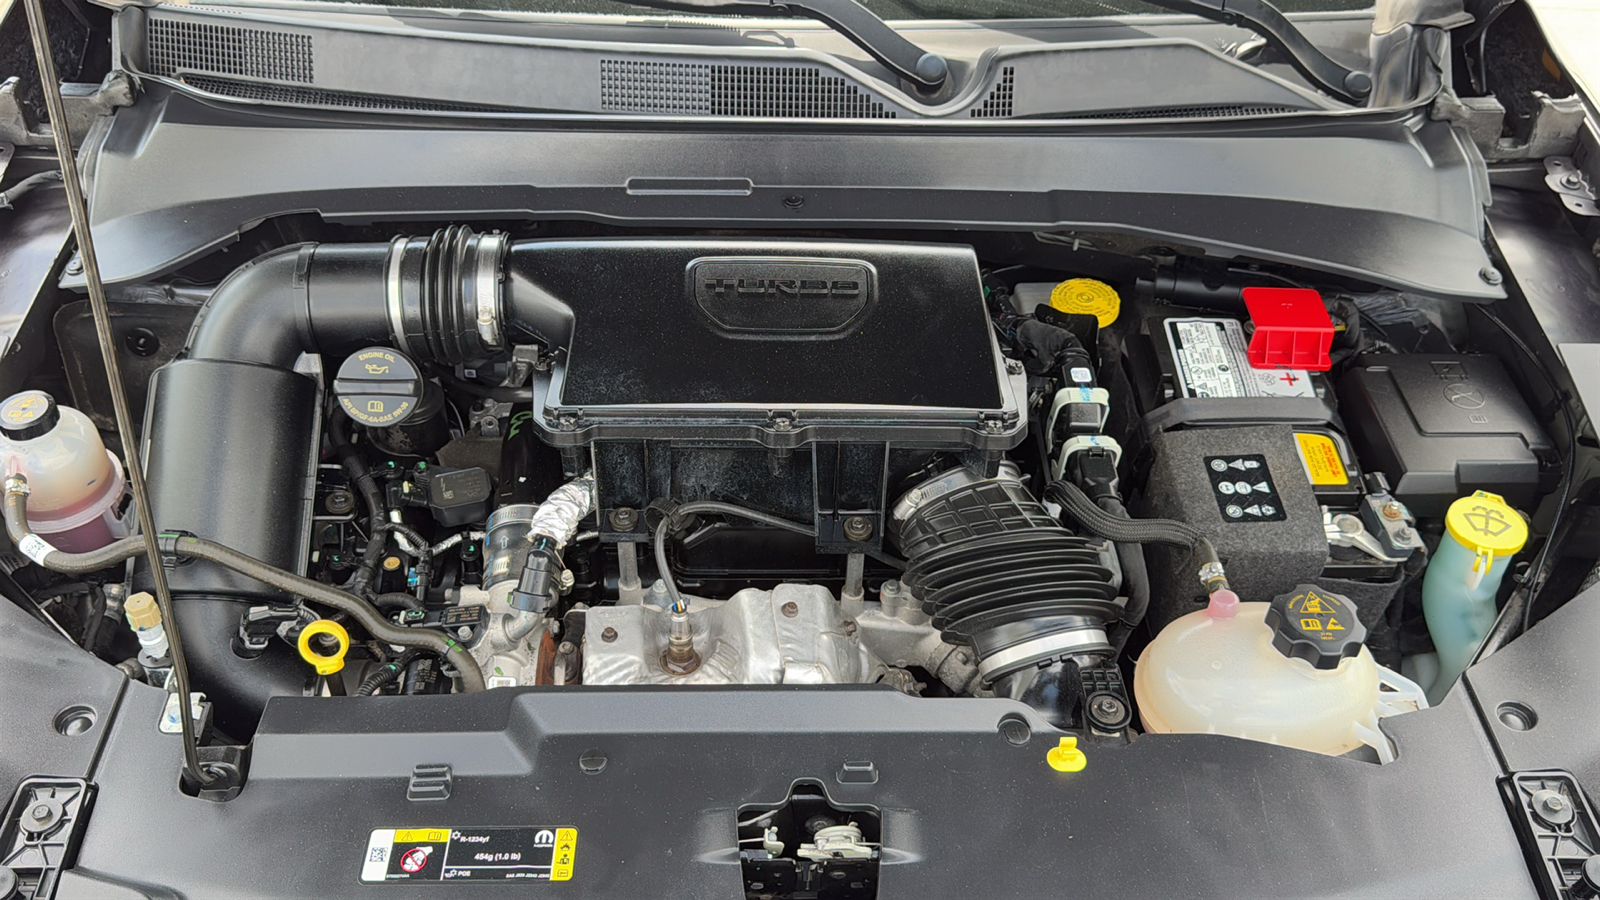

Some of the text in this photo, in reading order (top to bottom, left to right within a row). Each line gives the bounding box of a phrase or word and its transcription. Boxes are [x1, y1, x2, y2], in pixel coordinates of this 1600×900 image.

[704, 279, 859, 295] TURBO
[358, 352, 395, 363] ENGINE OIL
[392, 401, 409, 418] 5W-30
[460, 836, 490, 844] R-1234yf
[474, 852, 521, 862] 454g (1.0 lb)
